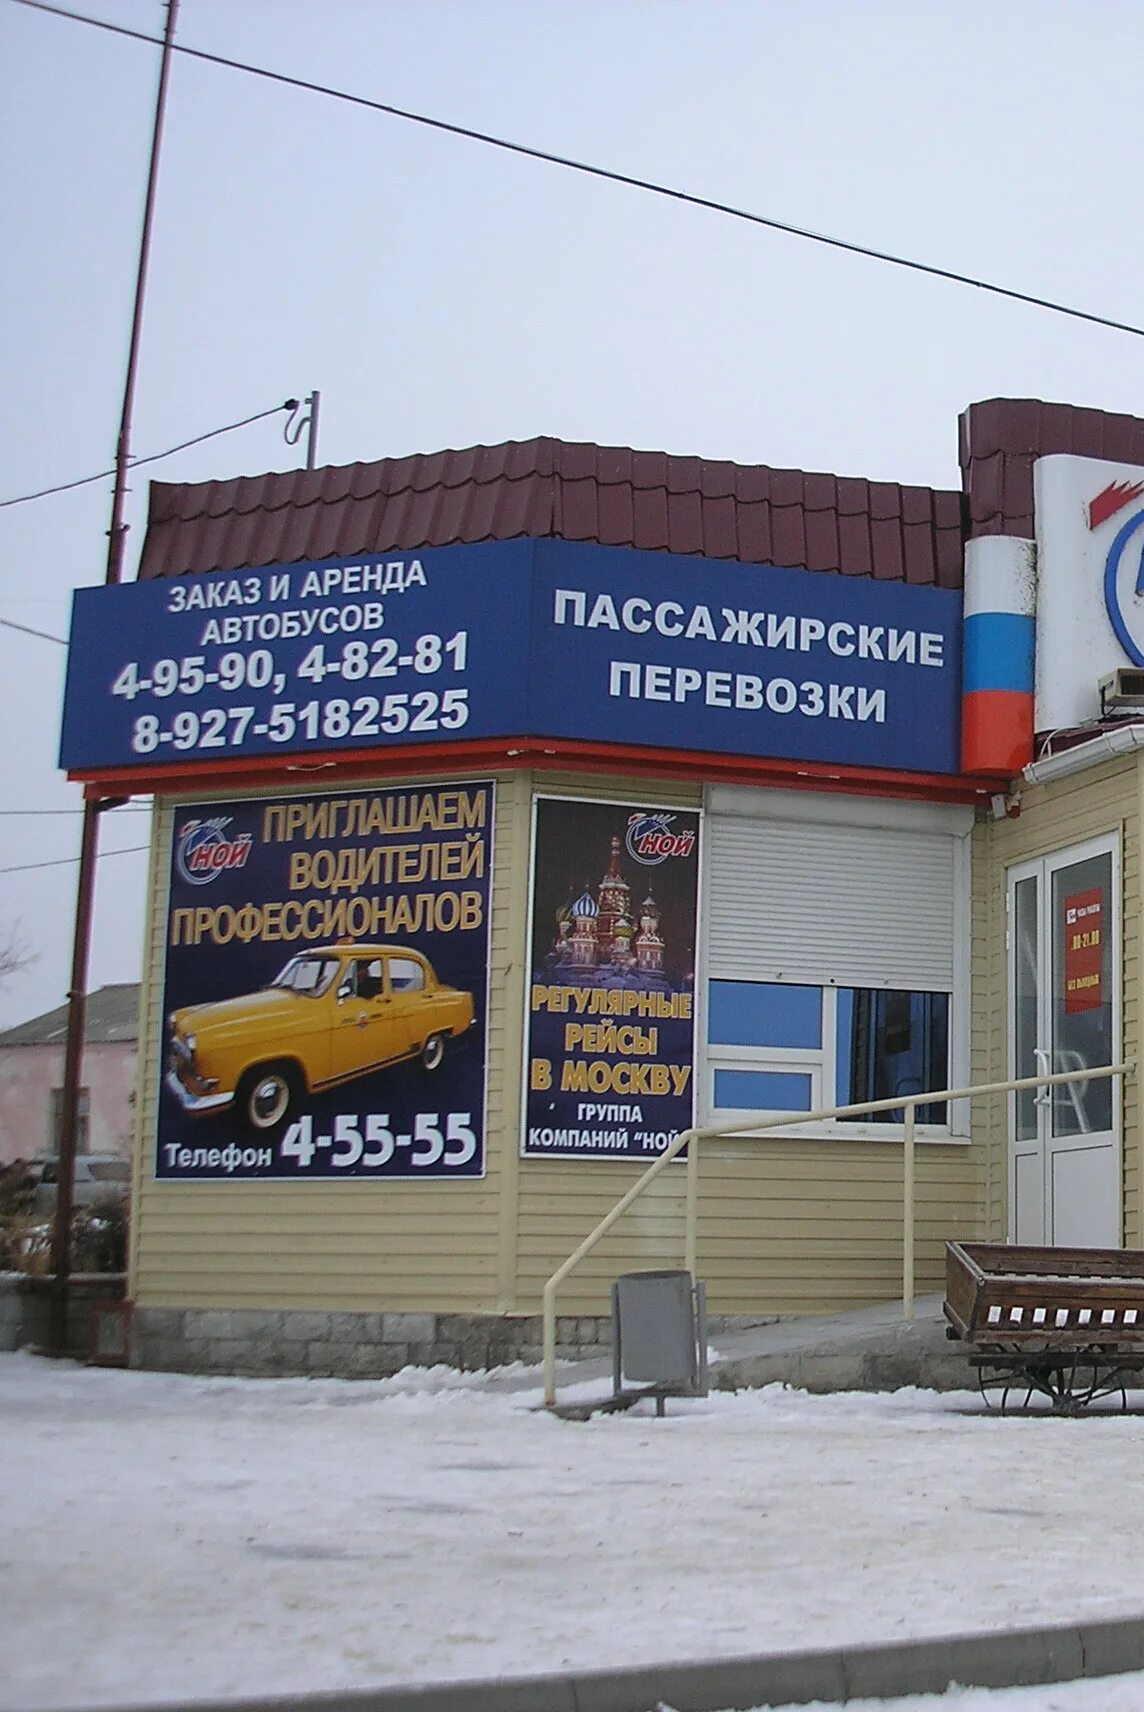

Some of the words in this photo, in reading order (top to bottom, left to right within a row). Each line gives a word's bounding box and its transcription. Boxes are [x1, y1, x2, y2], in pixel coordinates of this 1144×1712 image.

[167, 577, 261, 613] ЗАКАЗ
[268, 574, 290, 602] И
[299, 559, 427, 598] АРЕНДА
[200, 602, 385, 646] АВТОБУСОВ
[553, 588, 945, 668] ПАССАЖИРСКИЕ
[112, 649, 287, 700] 4-95-90,
[297, 631, 469, 684] 4-82-81
[608, 660, 887, 723] ПЕРЕВОЗКИ
[132, 688, 470, 754] 8-927-5182525
[263, 789, 487, 843] ПРИГЛАШАЕМ
[190, 833, 252, 872] НОЙ
[289, 832, 485, 895] ВОДИТЕЛЕЙ
[639, 830, 696, 858] НОЙ
[171, 890, 484, 946] ПРОФЕССИОНАЛОВ
[531, 985, 693, 1019] РЕГУЛЯРНЫЕ
[565, 1018, 658, 1056] РЕЙСЫ
[531, 1058, 553, 1091] В
[561, 1060, 692, 1097] МОСКВУ
[528, 1127, 628, 1150] КОМПАНИЙ
[577, 1103, 643, 1123] ГРУППА
[163, 1142, 272, 1173] Телефон
[280, 1112, 477, 1168] 4-55-55
